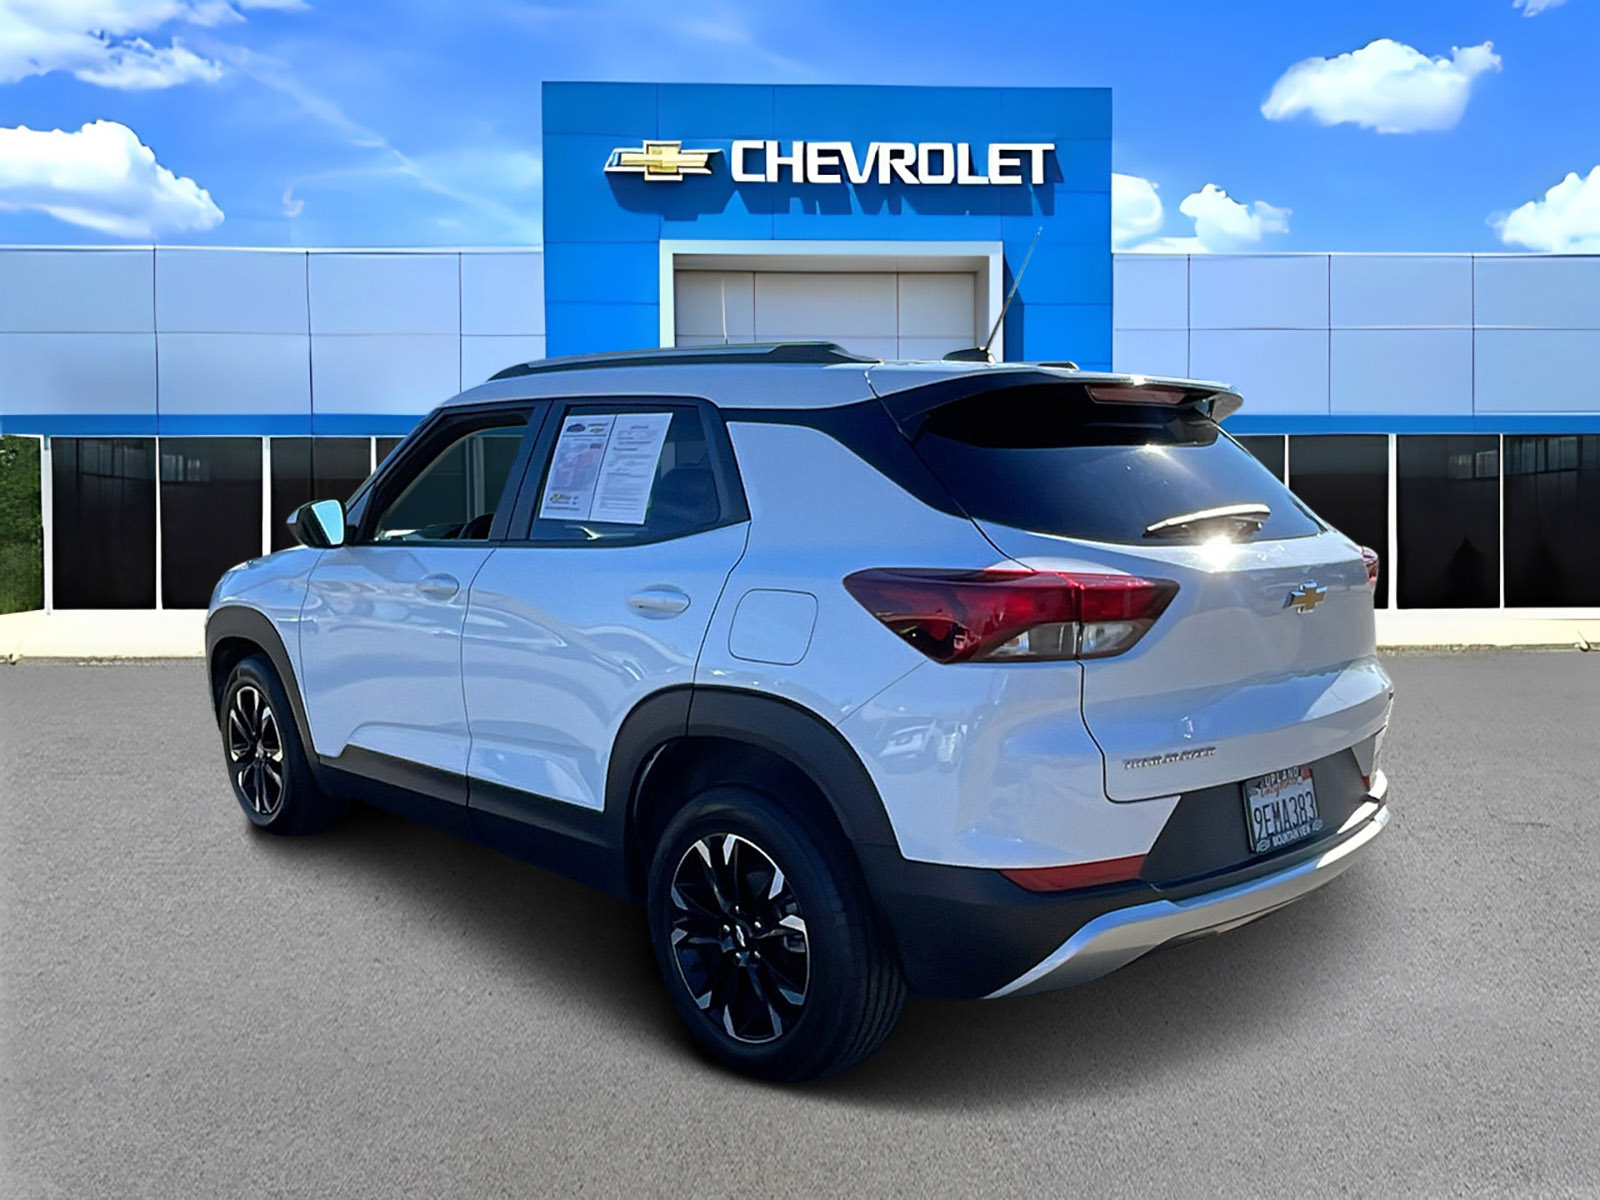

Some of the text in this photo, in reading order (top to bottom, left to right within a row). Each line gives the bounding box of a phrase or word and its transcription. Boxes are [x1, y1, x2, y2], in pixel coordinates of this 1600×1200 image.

[731, 141, 1056, 184] CHEVROLET
[1264, 767, 1299, 786] UPLAND
[1254, 791, 1316, 840] 9EMA383
